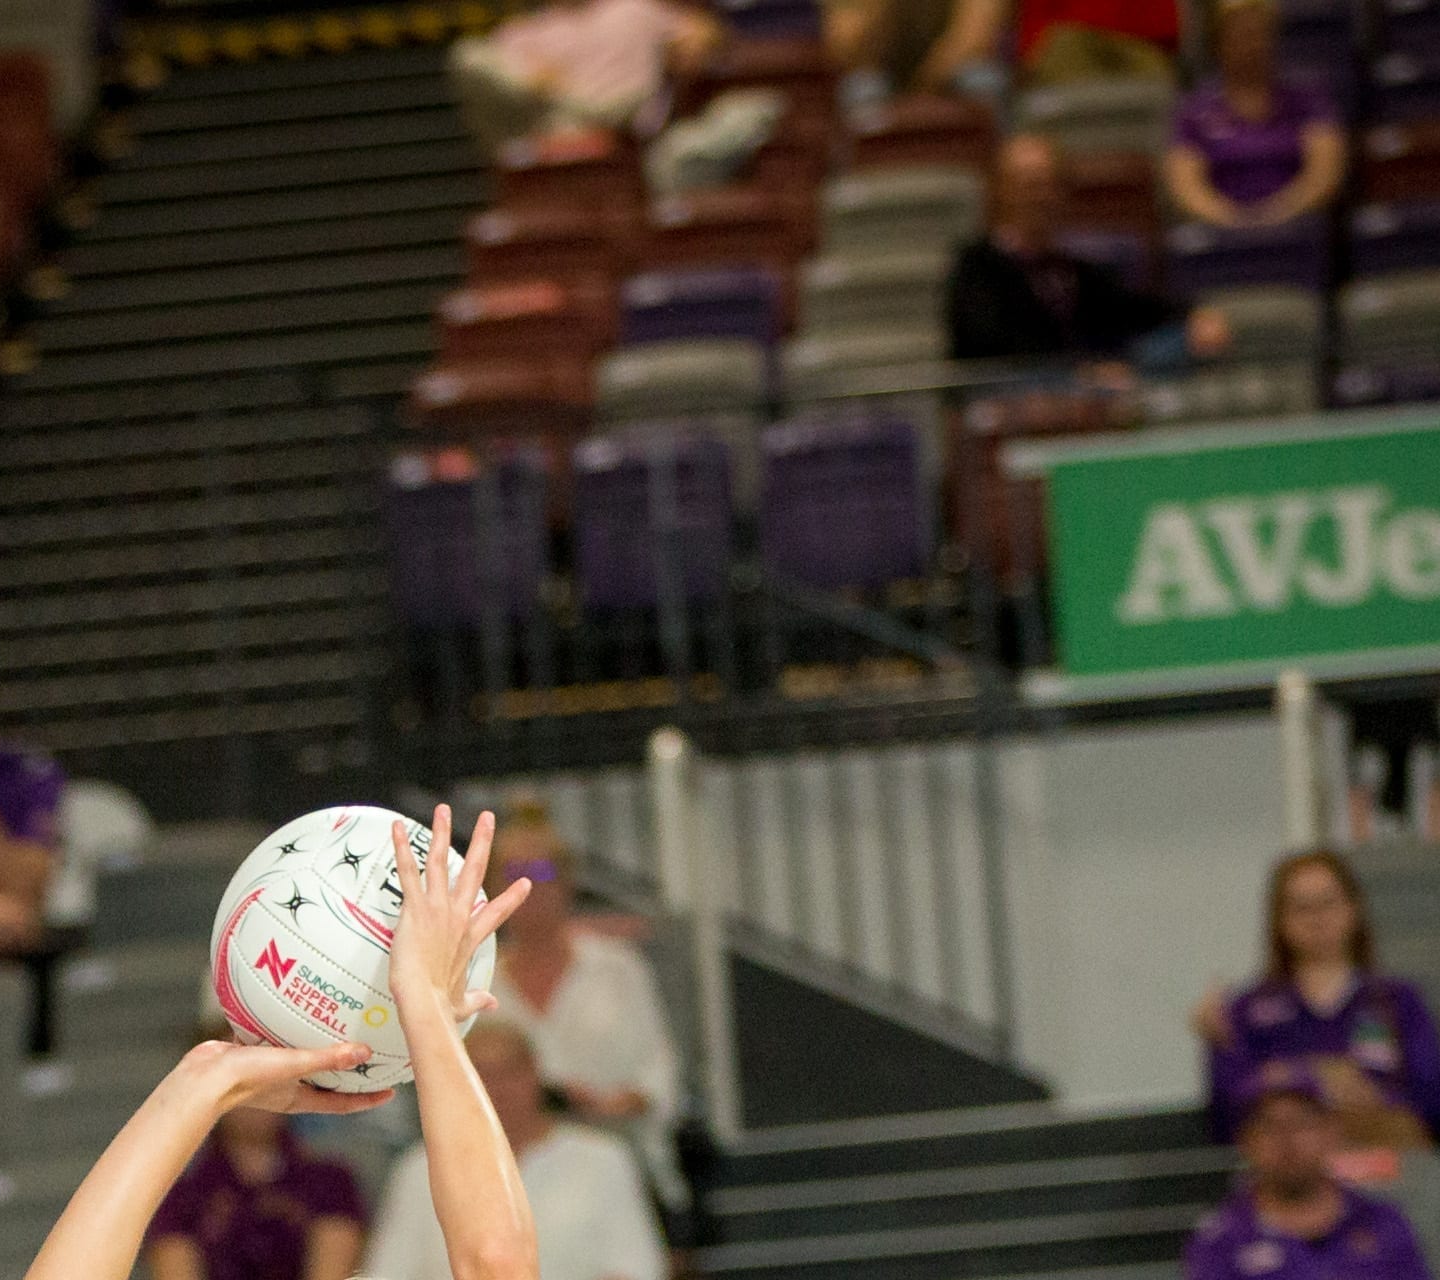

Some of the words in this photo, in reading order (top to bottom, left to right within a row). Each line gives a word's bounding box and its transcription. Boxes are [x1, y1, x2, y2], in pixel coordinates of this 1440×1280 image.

[290, 976, 339, 1014] SUPER
[297, 965, 364, 1010] SUNCORP
[283, 987, 347, 1035] NETBALL
